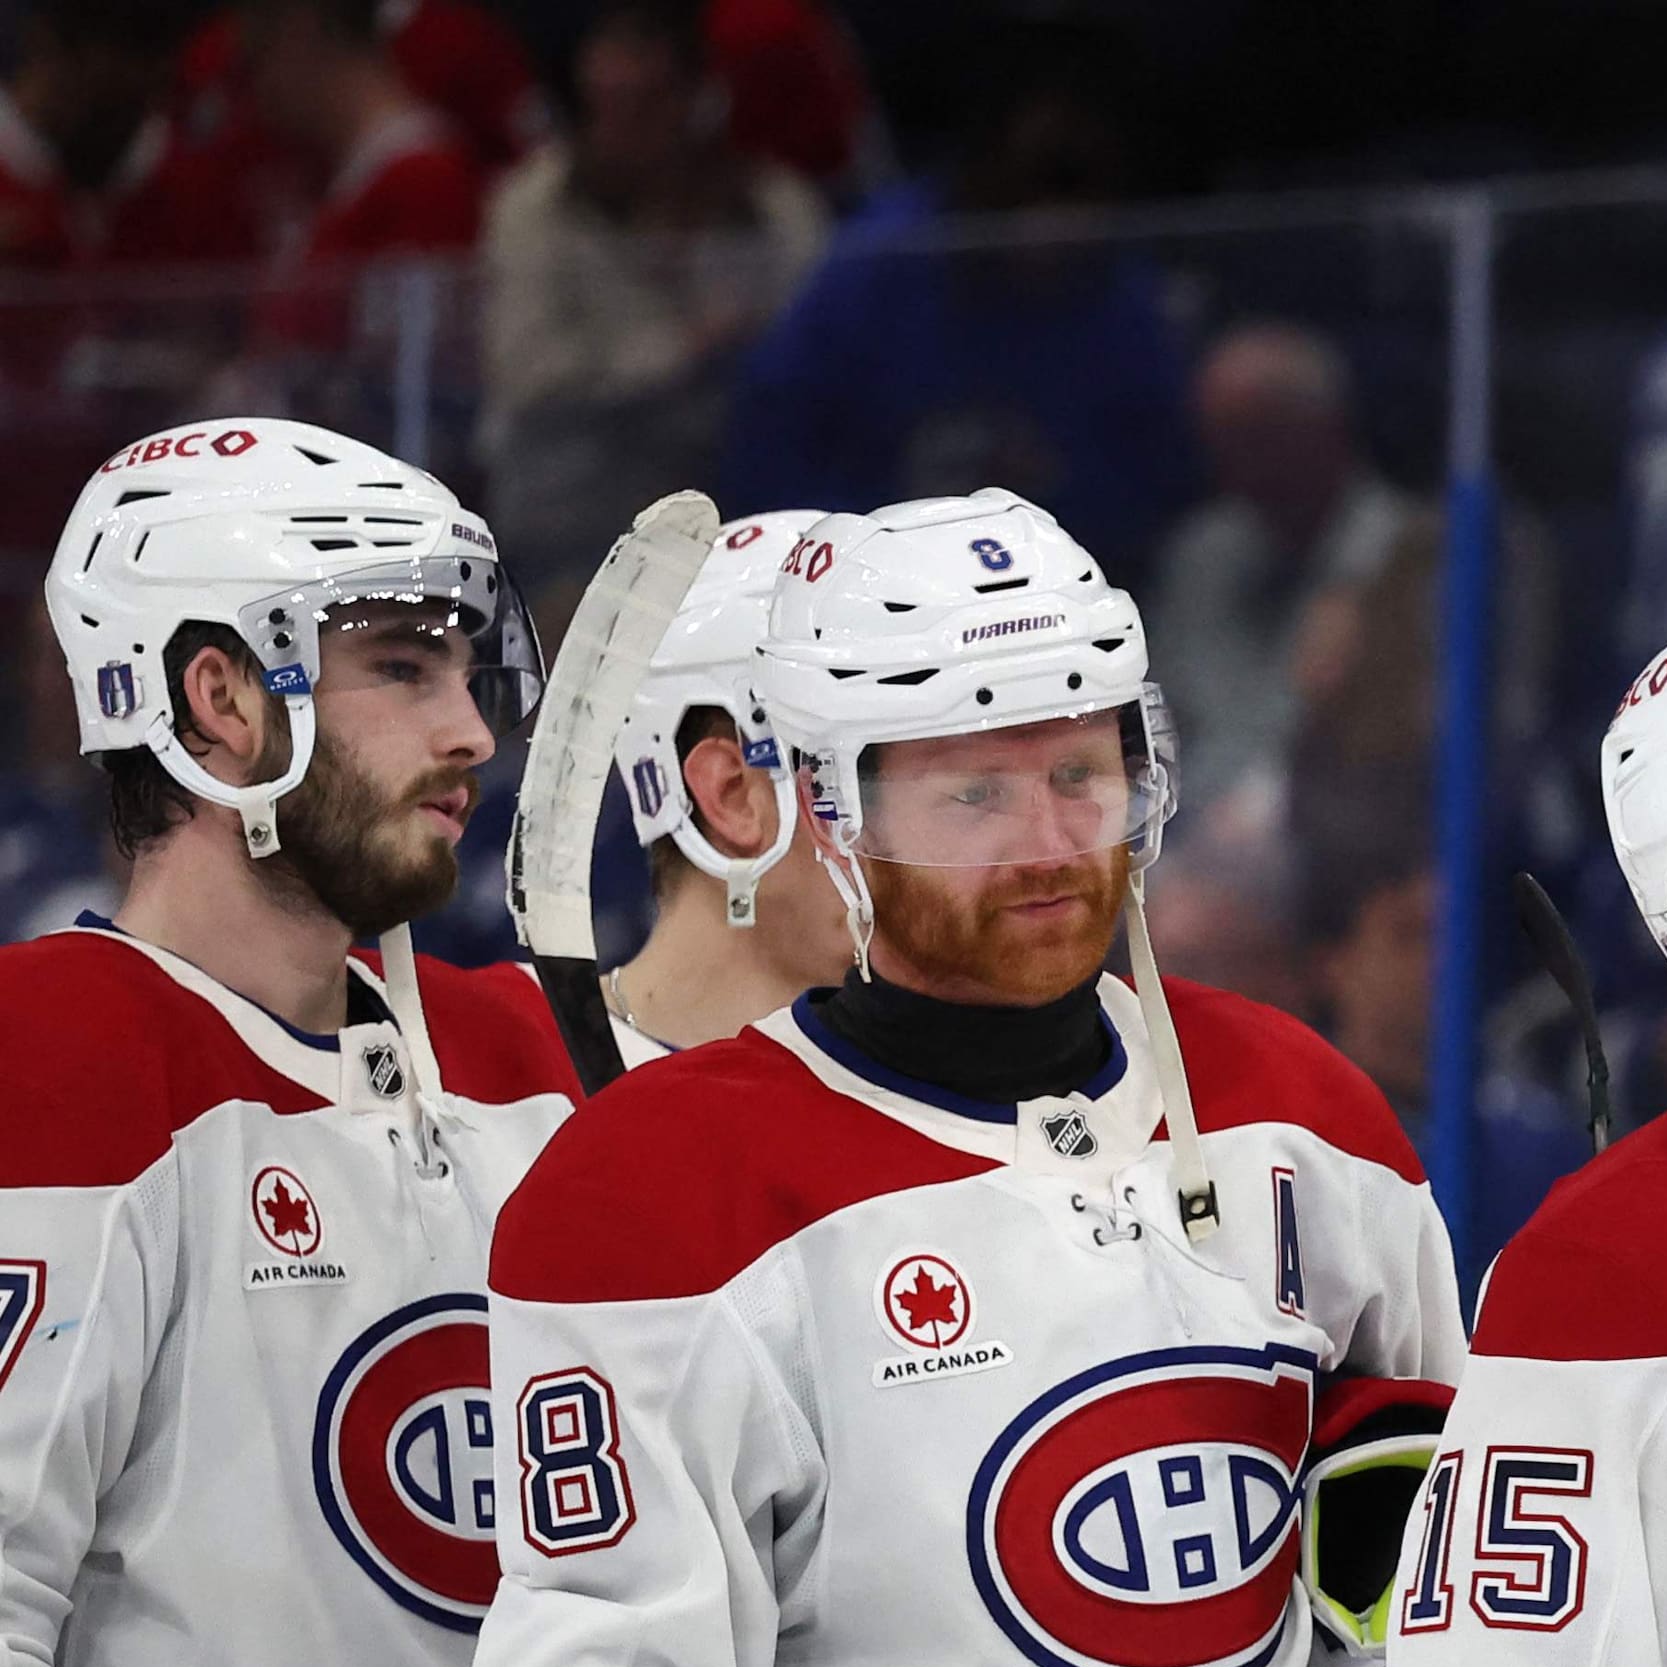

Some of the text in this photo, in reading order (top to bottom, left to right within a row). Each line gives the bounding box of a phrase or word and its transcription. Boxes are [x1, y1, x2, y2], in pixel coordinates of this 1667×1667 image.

[961, 613, 1067, 644] WARRIOR
[251, 1264, 346, 1282] AIR CANADA
[1271, 1166, 1305, 1318] A
[882, 1346, 1006, 1382] AIR CANADA
[516, 1366, 637, 1558] 8
[1400, 1446, 1595, 1635] 15
